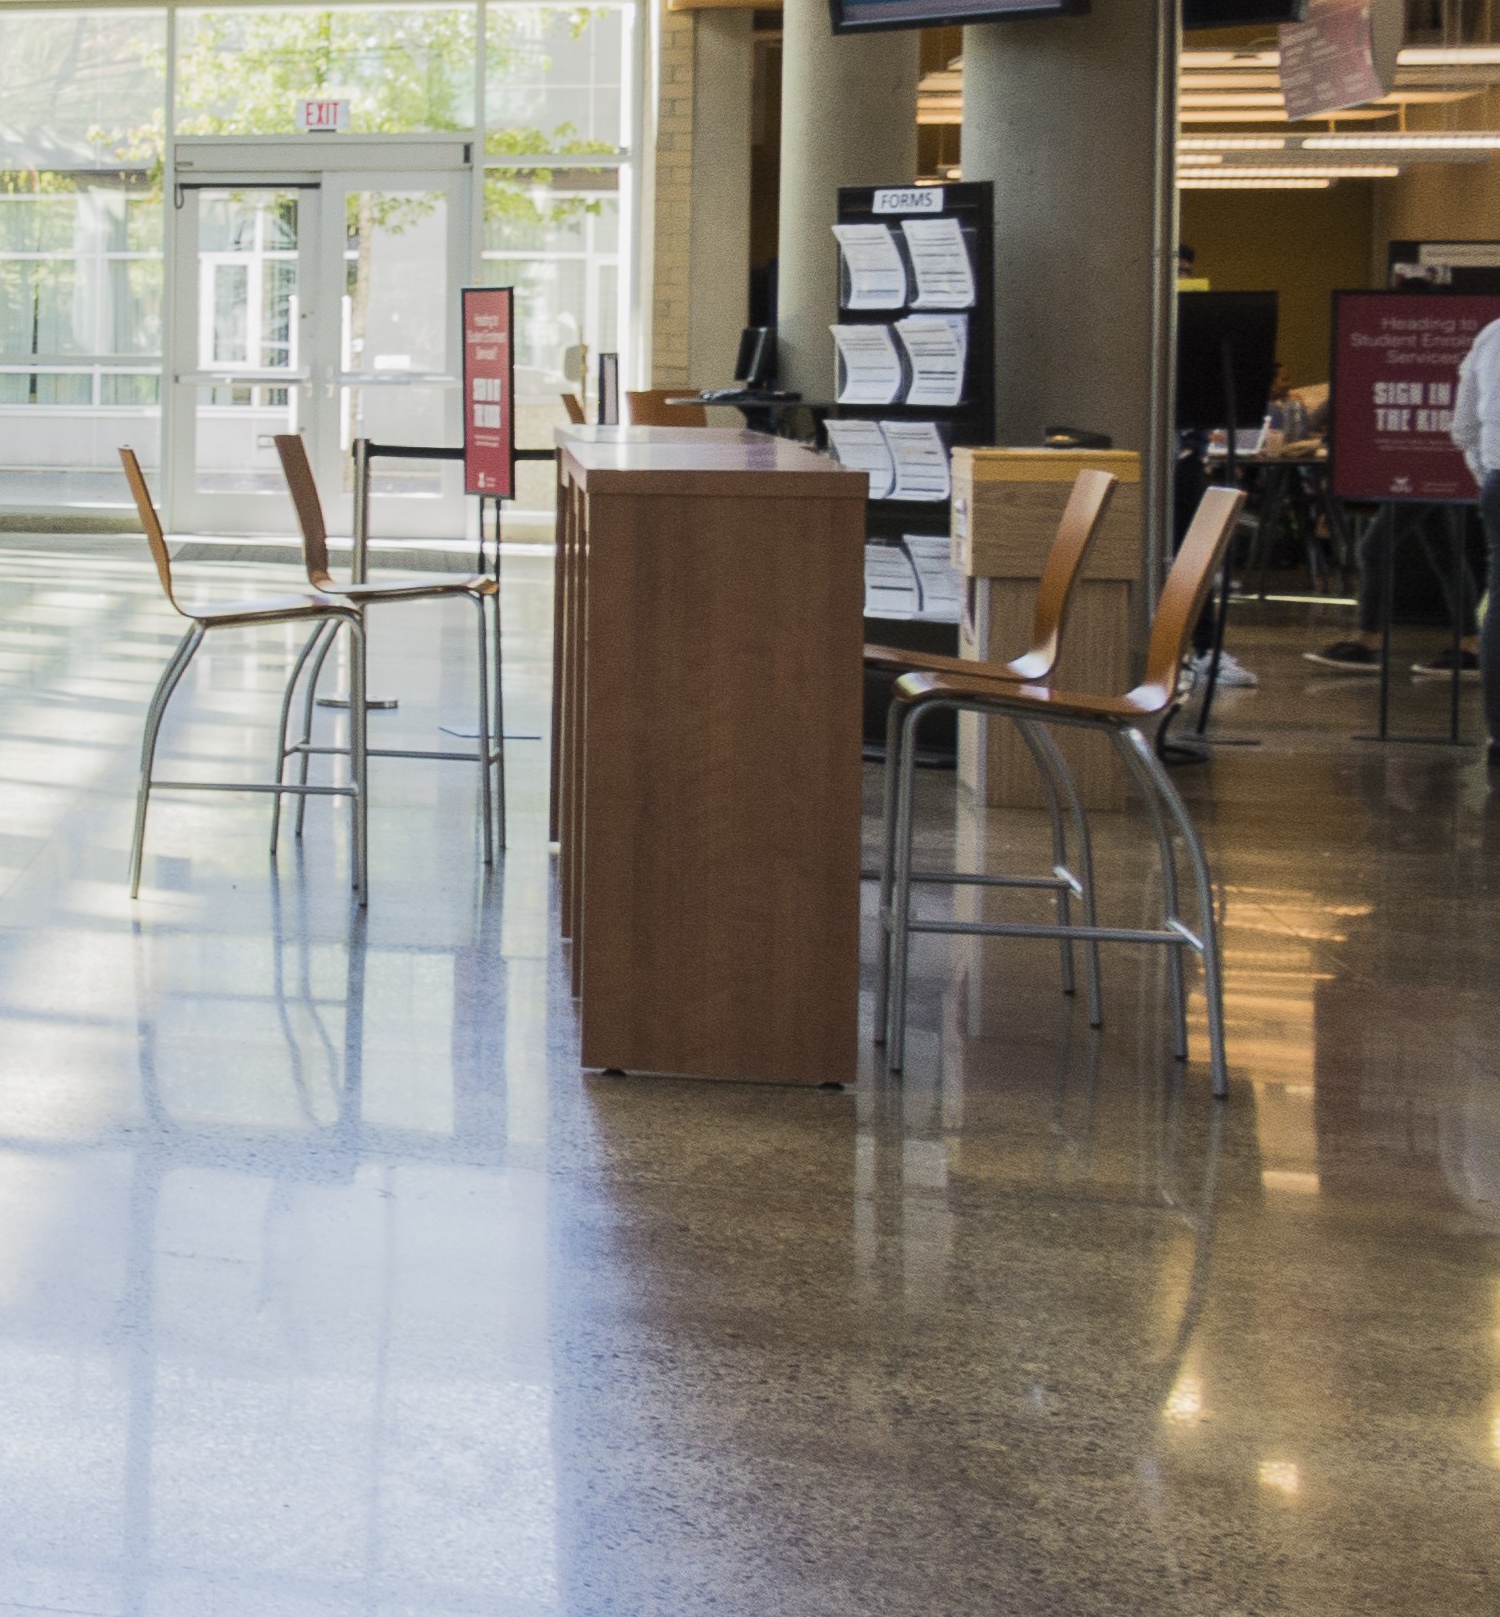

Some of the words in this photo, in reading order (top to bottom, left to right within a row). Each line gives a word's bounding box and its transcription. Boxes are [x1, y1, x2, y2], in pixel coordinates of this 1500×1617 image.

[306, 101, 338, 125] EXIT
[881, 192, 932, 208] FORMS
[1381, 317, 1456, 333] Heading
[1459, 317, 1478, 331] to
[1350, 332, 1418, 348] Student
[1422, 333, 1473, 348] Enrol
[1373, 382, 1423, 405] SIGN
[1429, 383, 1451, 405] IN
[1374, 408, 1411, 432] THE
